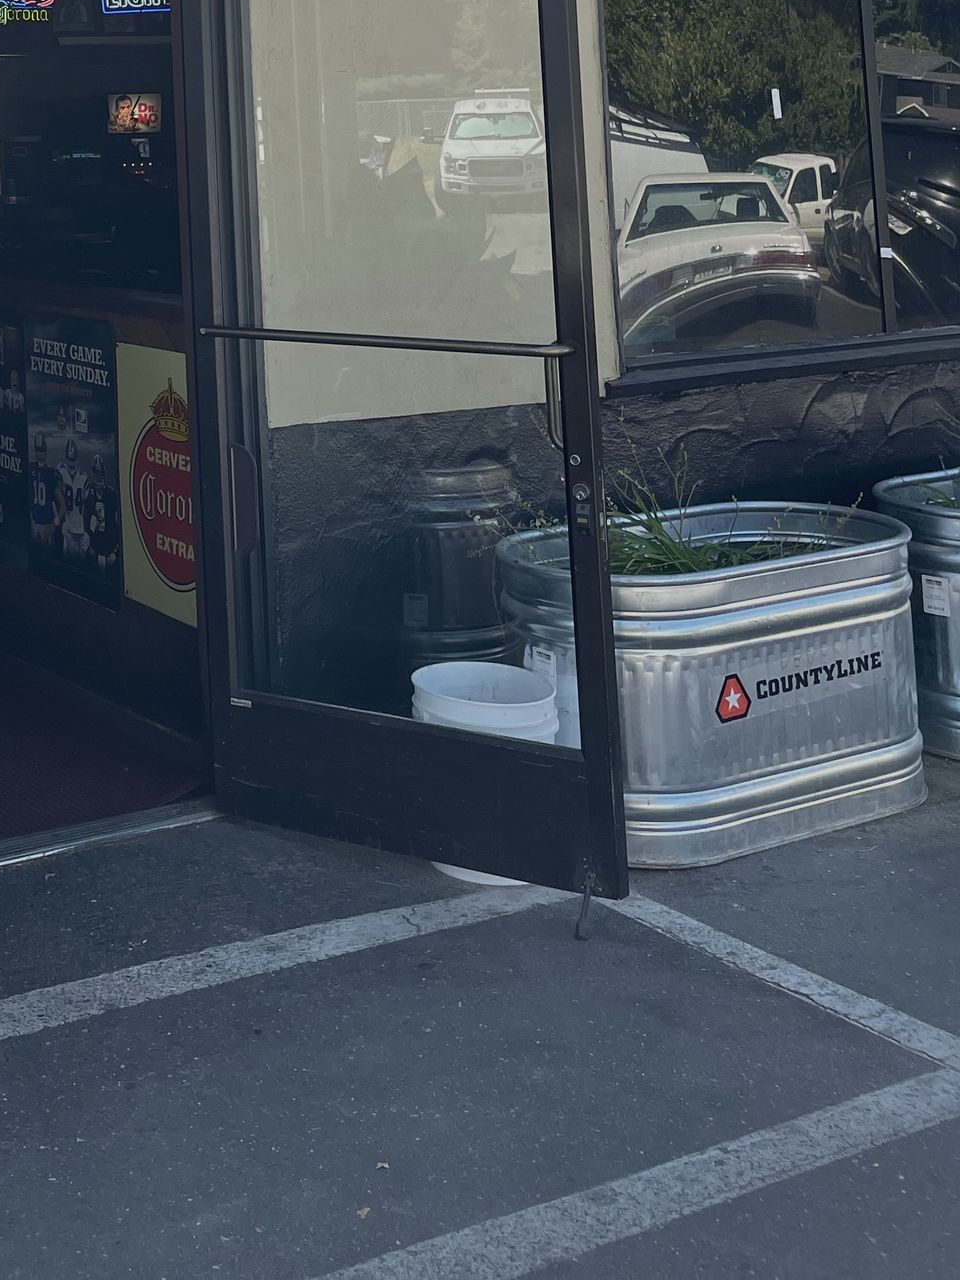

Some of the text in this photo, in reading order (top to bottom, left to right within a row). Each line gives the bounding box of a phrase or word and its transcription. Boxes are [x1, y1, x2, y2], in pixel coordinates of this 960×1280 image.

[33, 338, 106, 367] EVERY GAME.
[30, 356, 110, 387] EVERY SUNDAY.
[156, 533, 195, 562] EXTRA
[756, 651, 882, 701] COUNTYLINE
